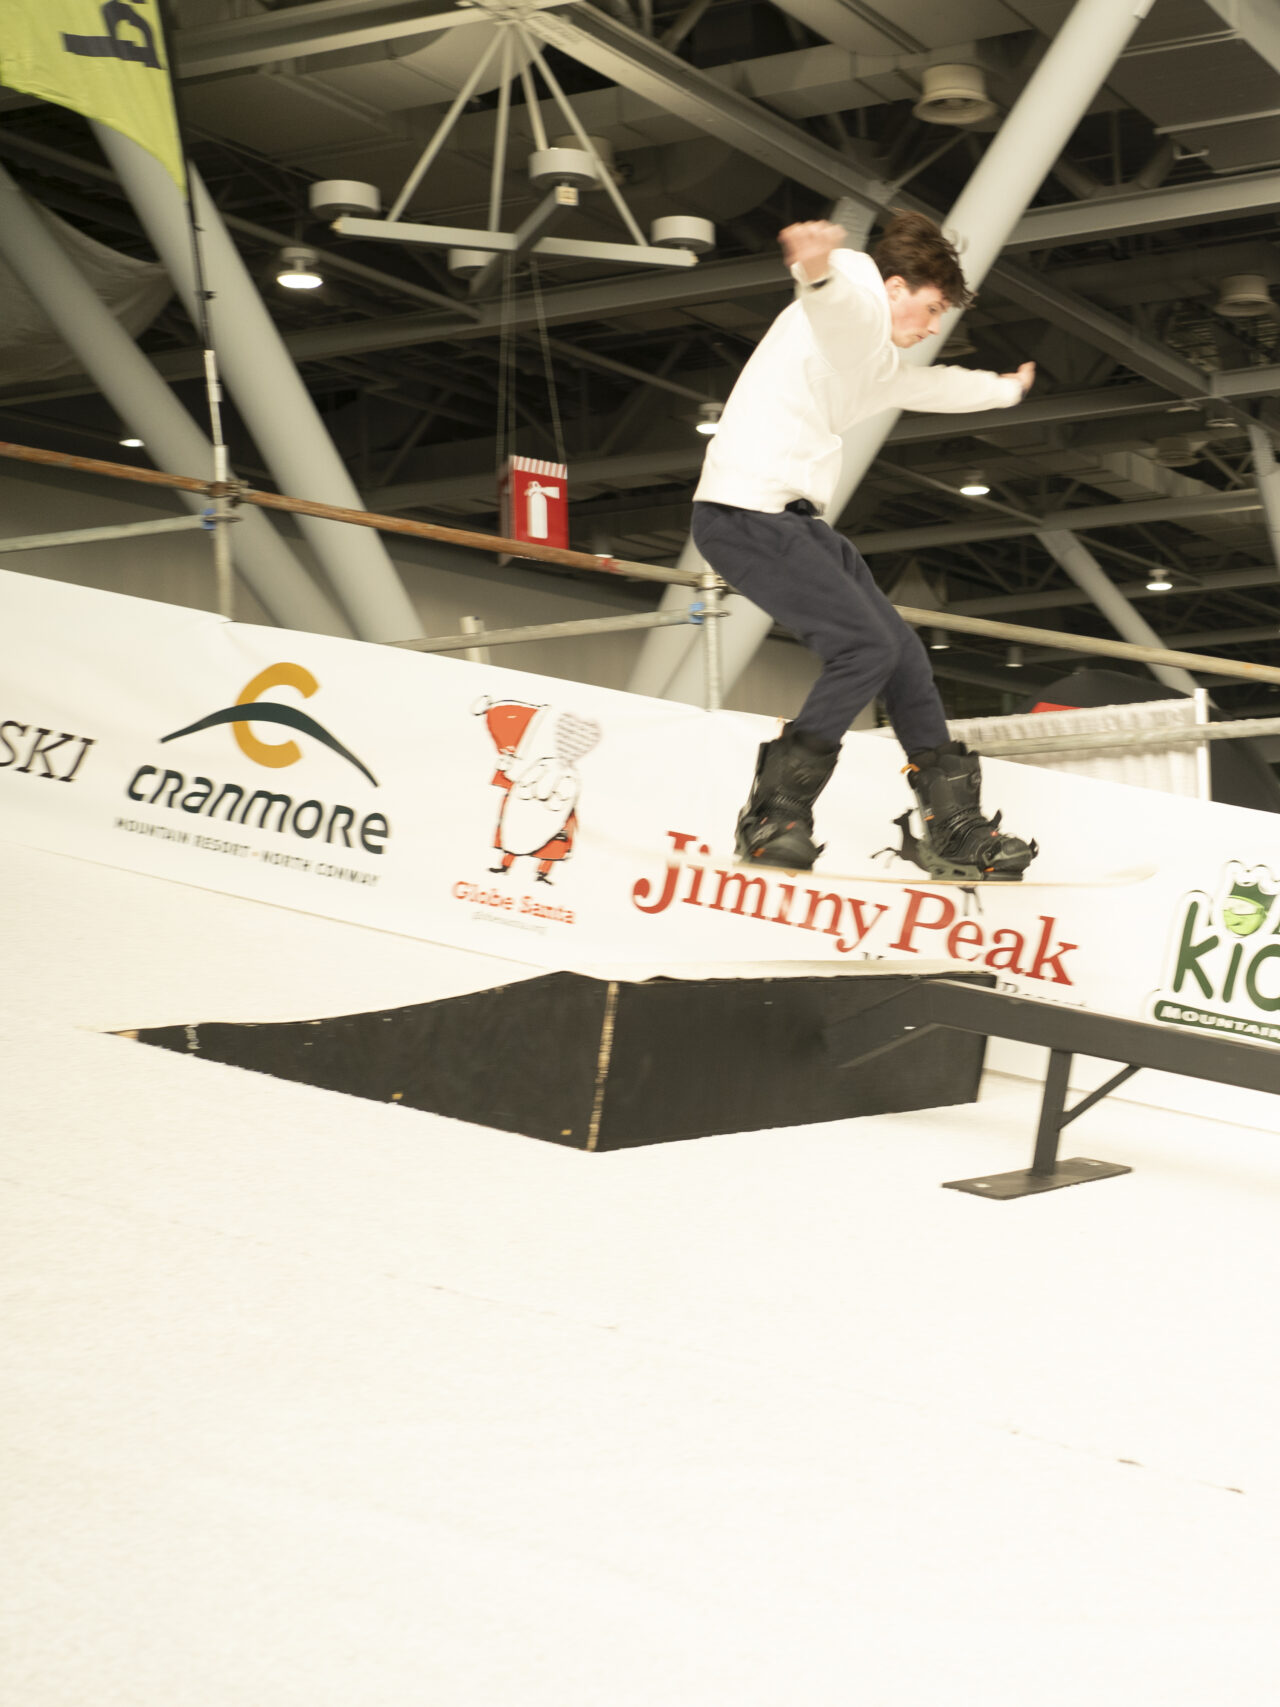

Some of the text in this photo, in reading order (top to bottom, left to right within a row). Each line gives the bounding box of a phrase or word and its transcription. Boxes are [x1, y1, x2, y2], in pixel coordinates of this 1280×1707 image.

[0, 720, 97, 783] SKI
[114, 816, 381, 887] MOUNTAIN RESORT NORTH CONWAY
[452, 880, 514, 911] Globe
[518, 894, 576, 925] Santa
[632, 830, 1080, 986] Jiminy Peak
